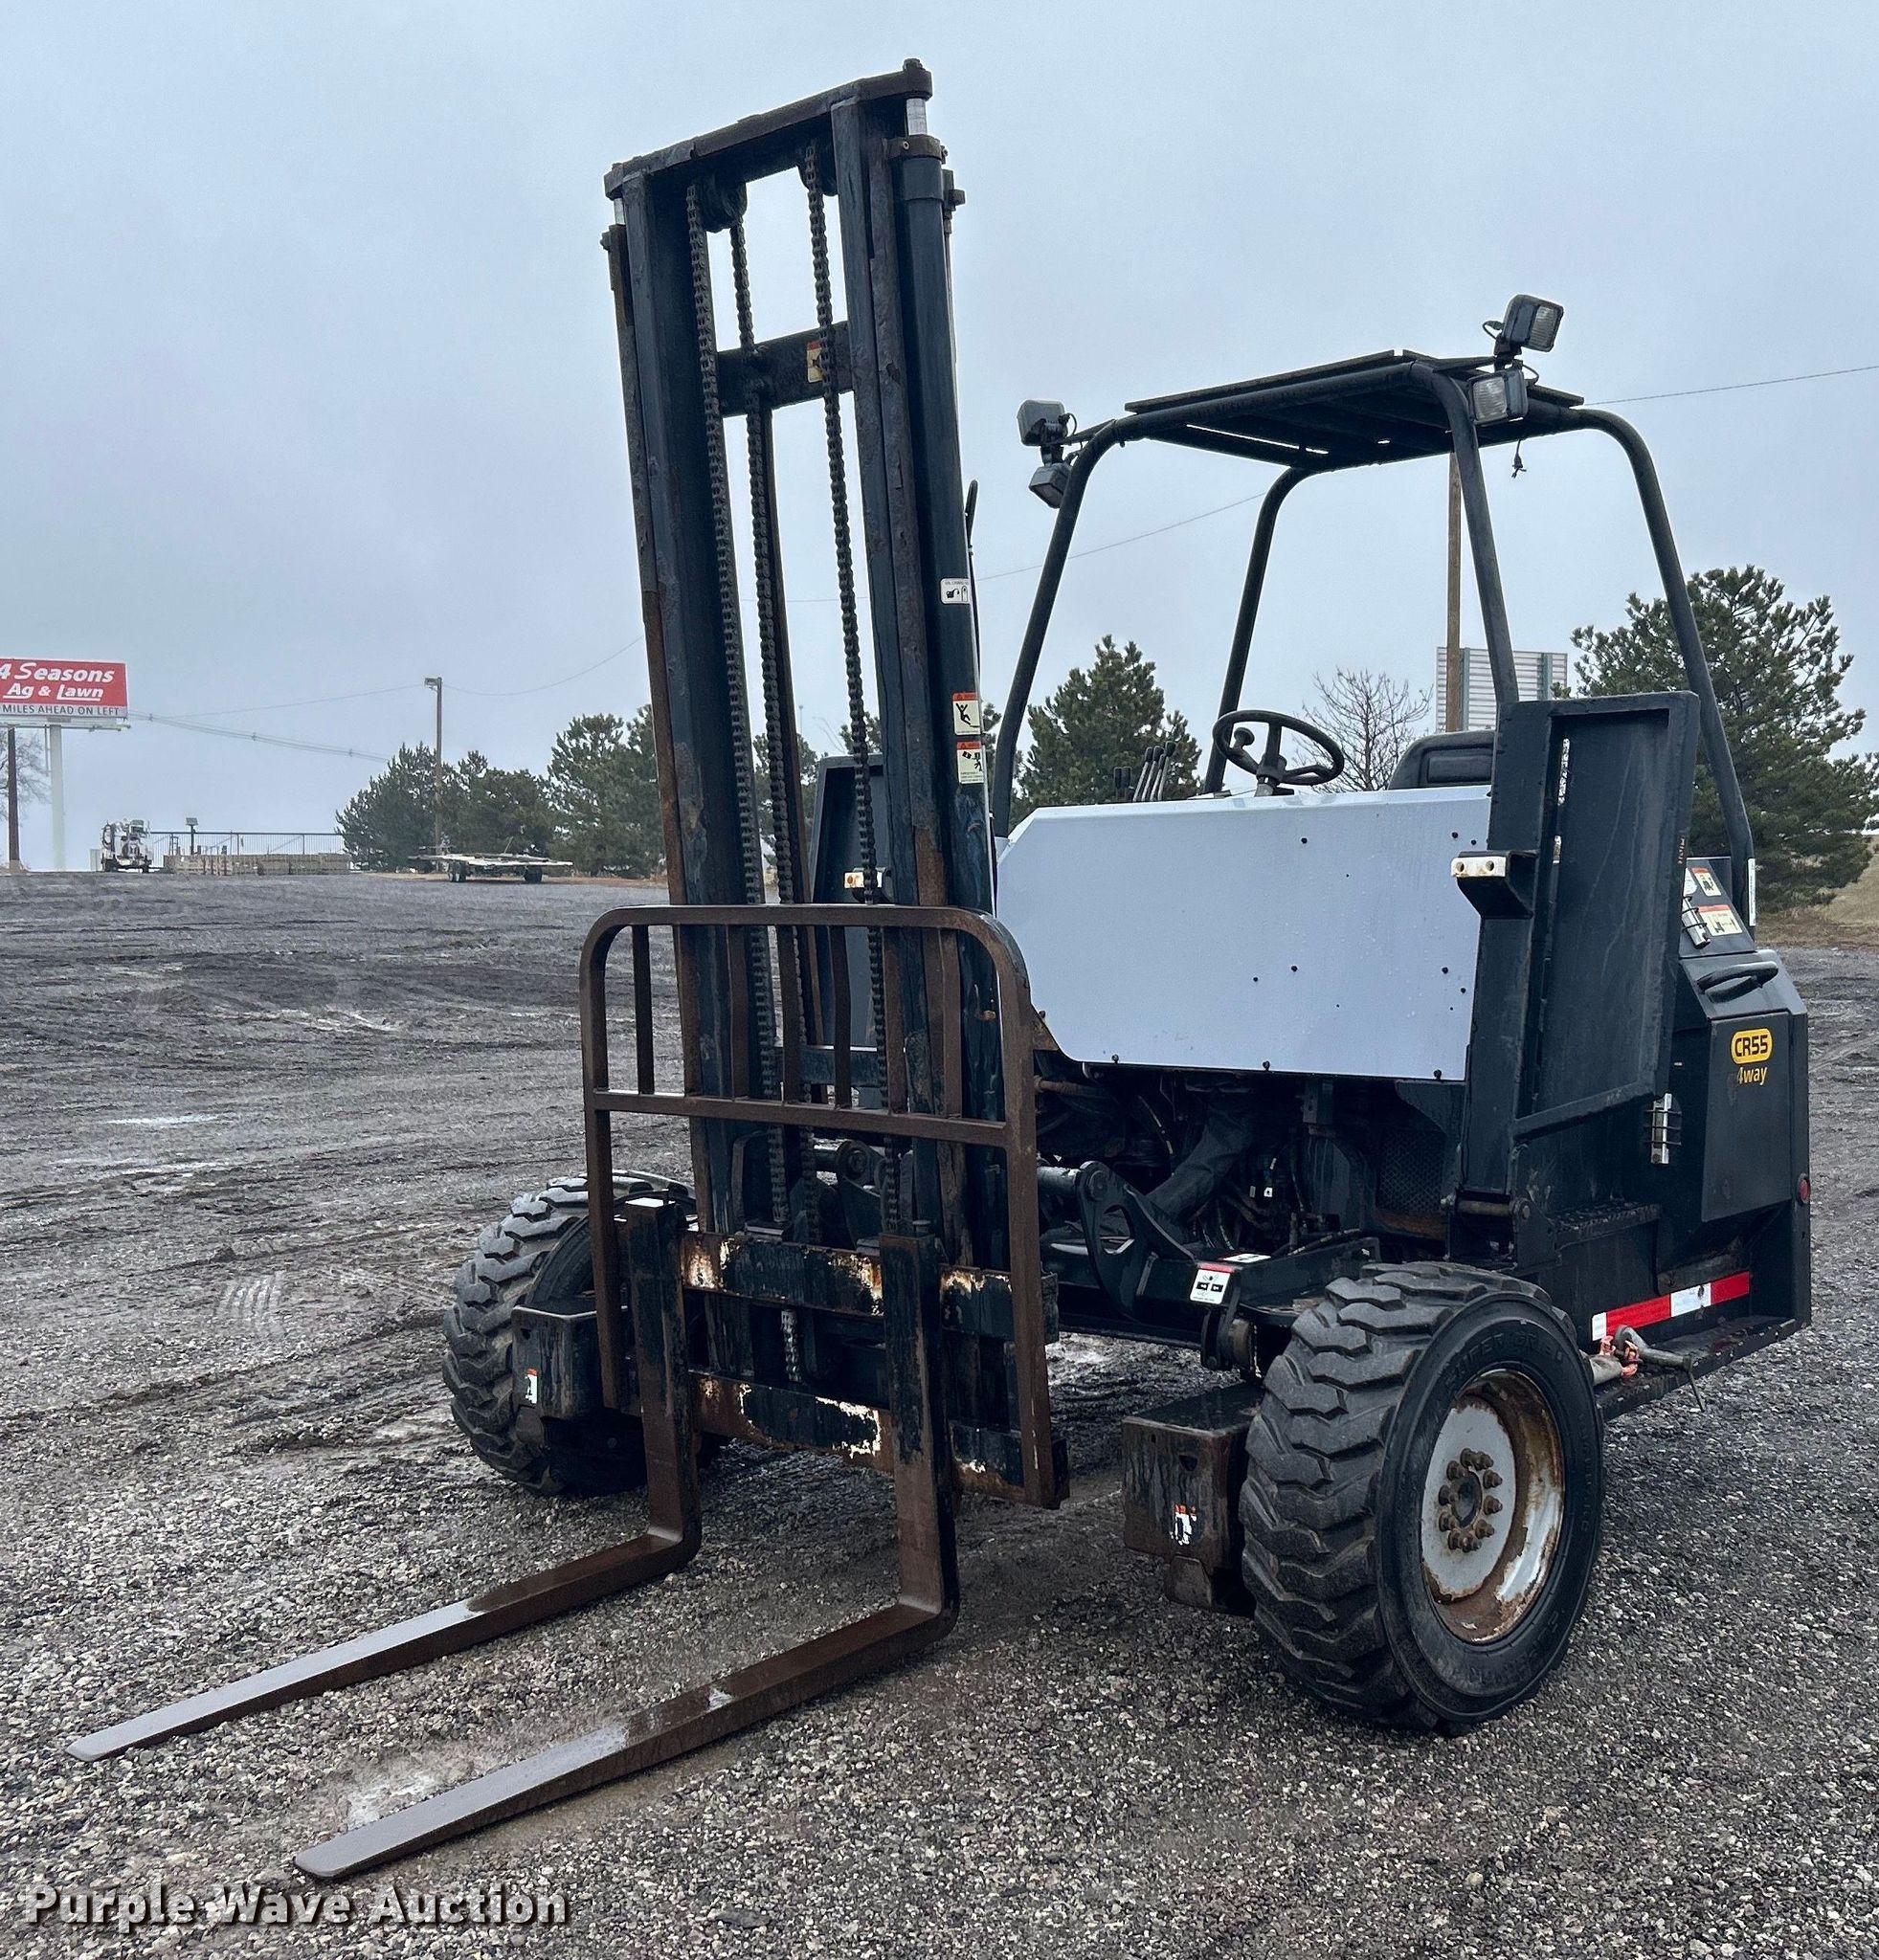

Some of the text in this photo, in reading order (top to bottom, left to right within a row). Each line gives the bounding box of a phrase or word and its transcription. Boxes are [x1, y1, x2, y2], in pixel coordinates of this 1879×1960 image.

[0, 661, 115, 683] 4 Seasons
[3, 682, 104, 702] Ag & Lawn
[3, 704, 120, 716] MILES AHEAD ON LEFT
[1734, 1035, 1769, 1058] CR55
[1737, 1066, 1768, 1086] 4way
